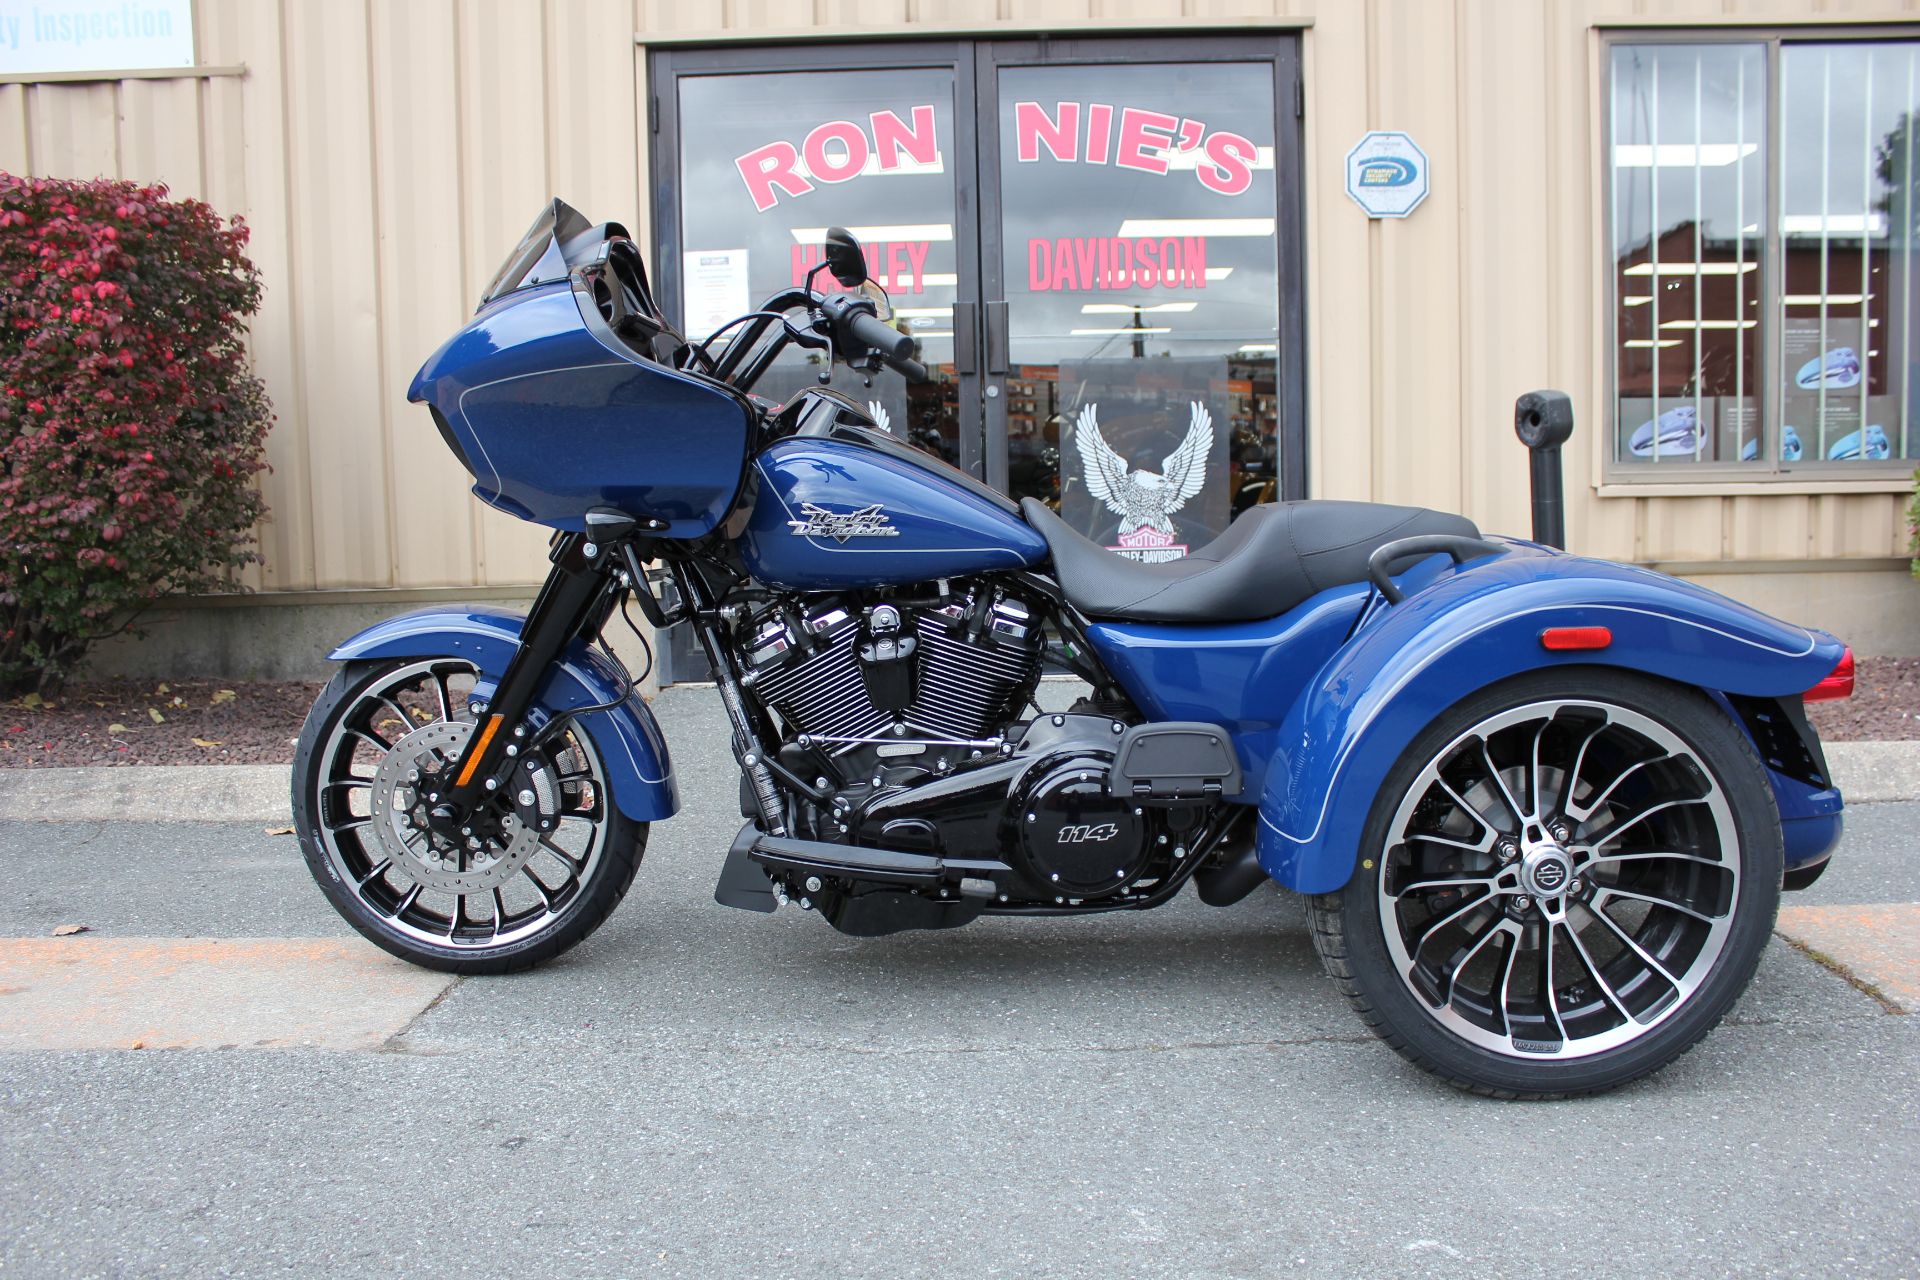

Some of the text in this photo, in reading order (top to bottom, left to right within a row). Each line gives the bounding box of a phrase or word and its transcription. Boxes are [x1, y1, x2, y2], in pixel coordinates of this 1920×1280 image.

[33, 3, 173, 45] Inspection
[734, 101, 1259, 213] RON NIE'S
[791, 236, 1207, 295] HALEY DAVIDSON
[787, 520, 900, 537] Davidson
[1127, 532, 1166, 547] MOTOR
[1057, 823, 1119, 843] 114
